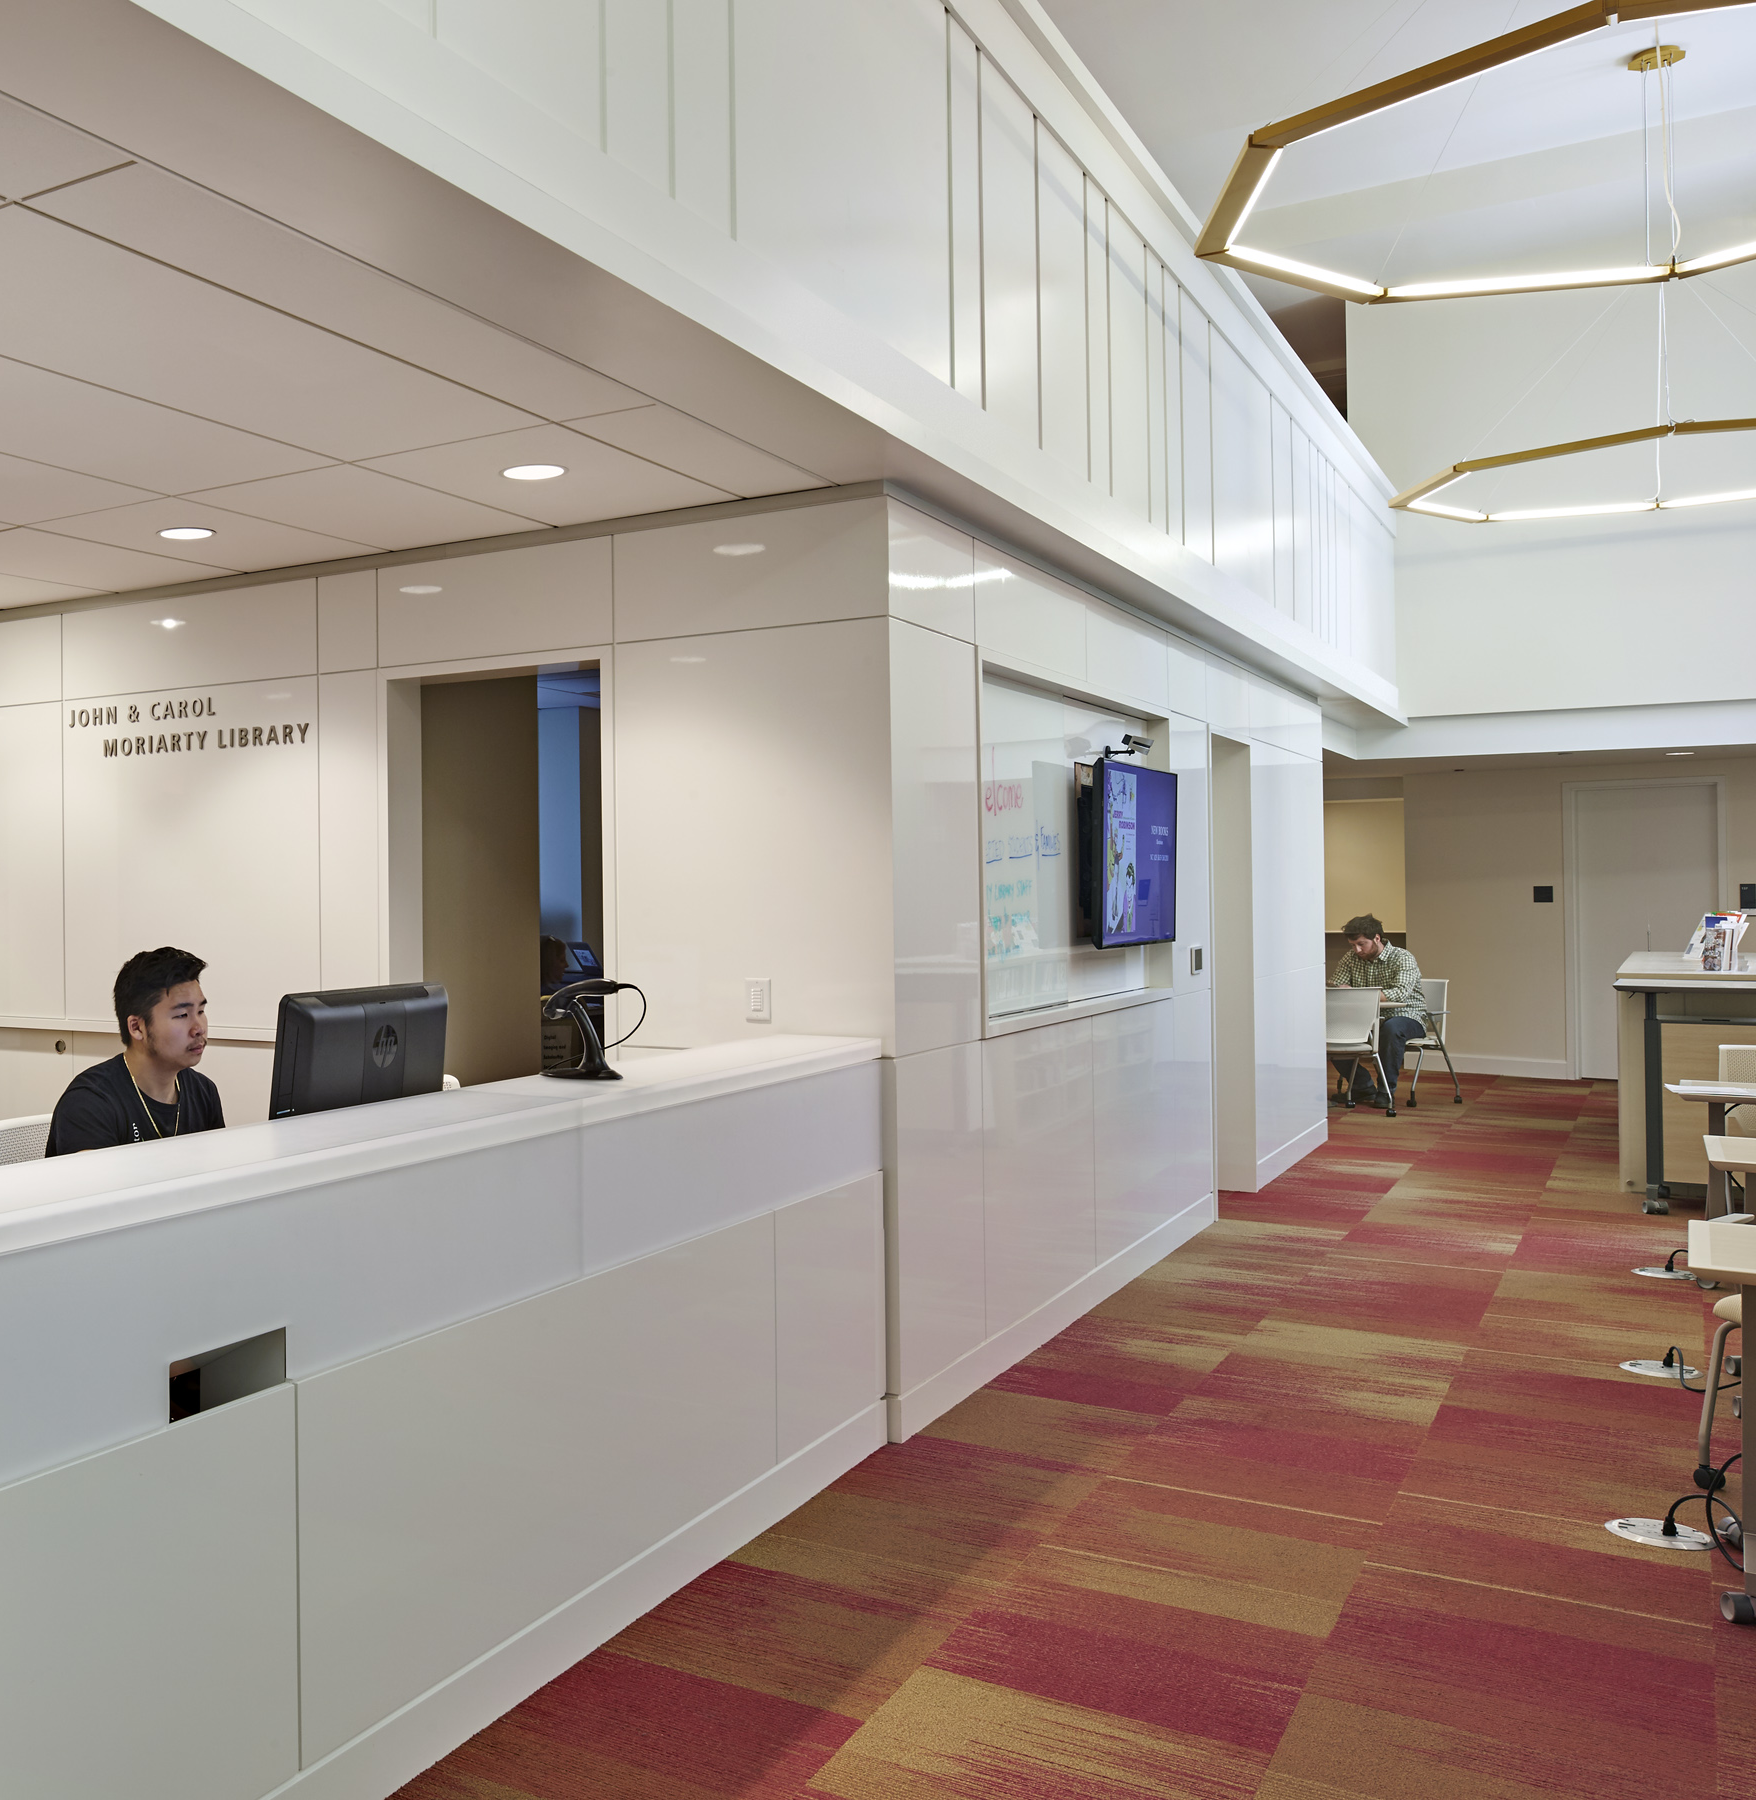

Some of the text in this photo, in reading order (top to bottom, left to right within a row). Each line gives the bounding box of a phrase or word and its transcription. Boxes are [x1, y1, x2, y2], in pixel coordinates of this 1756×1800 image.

[69, 697, 216, 728] JOHN & CAROL
[103, 722, 310, 758] MORIARTY LIBRARY
[374, 1024, 396, 1068] hp
